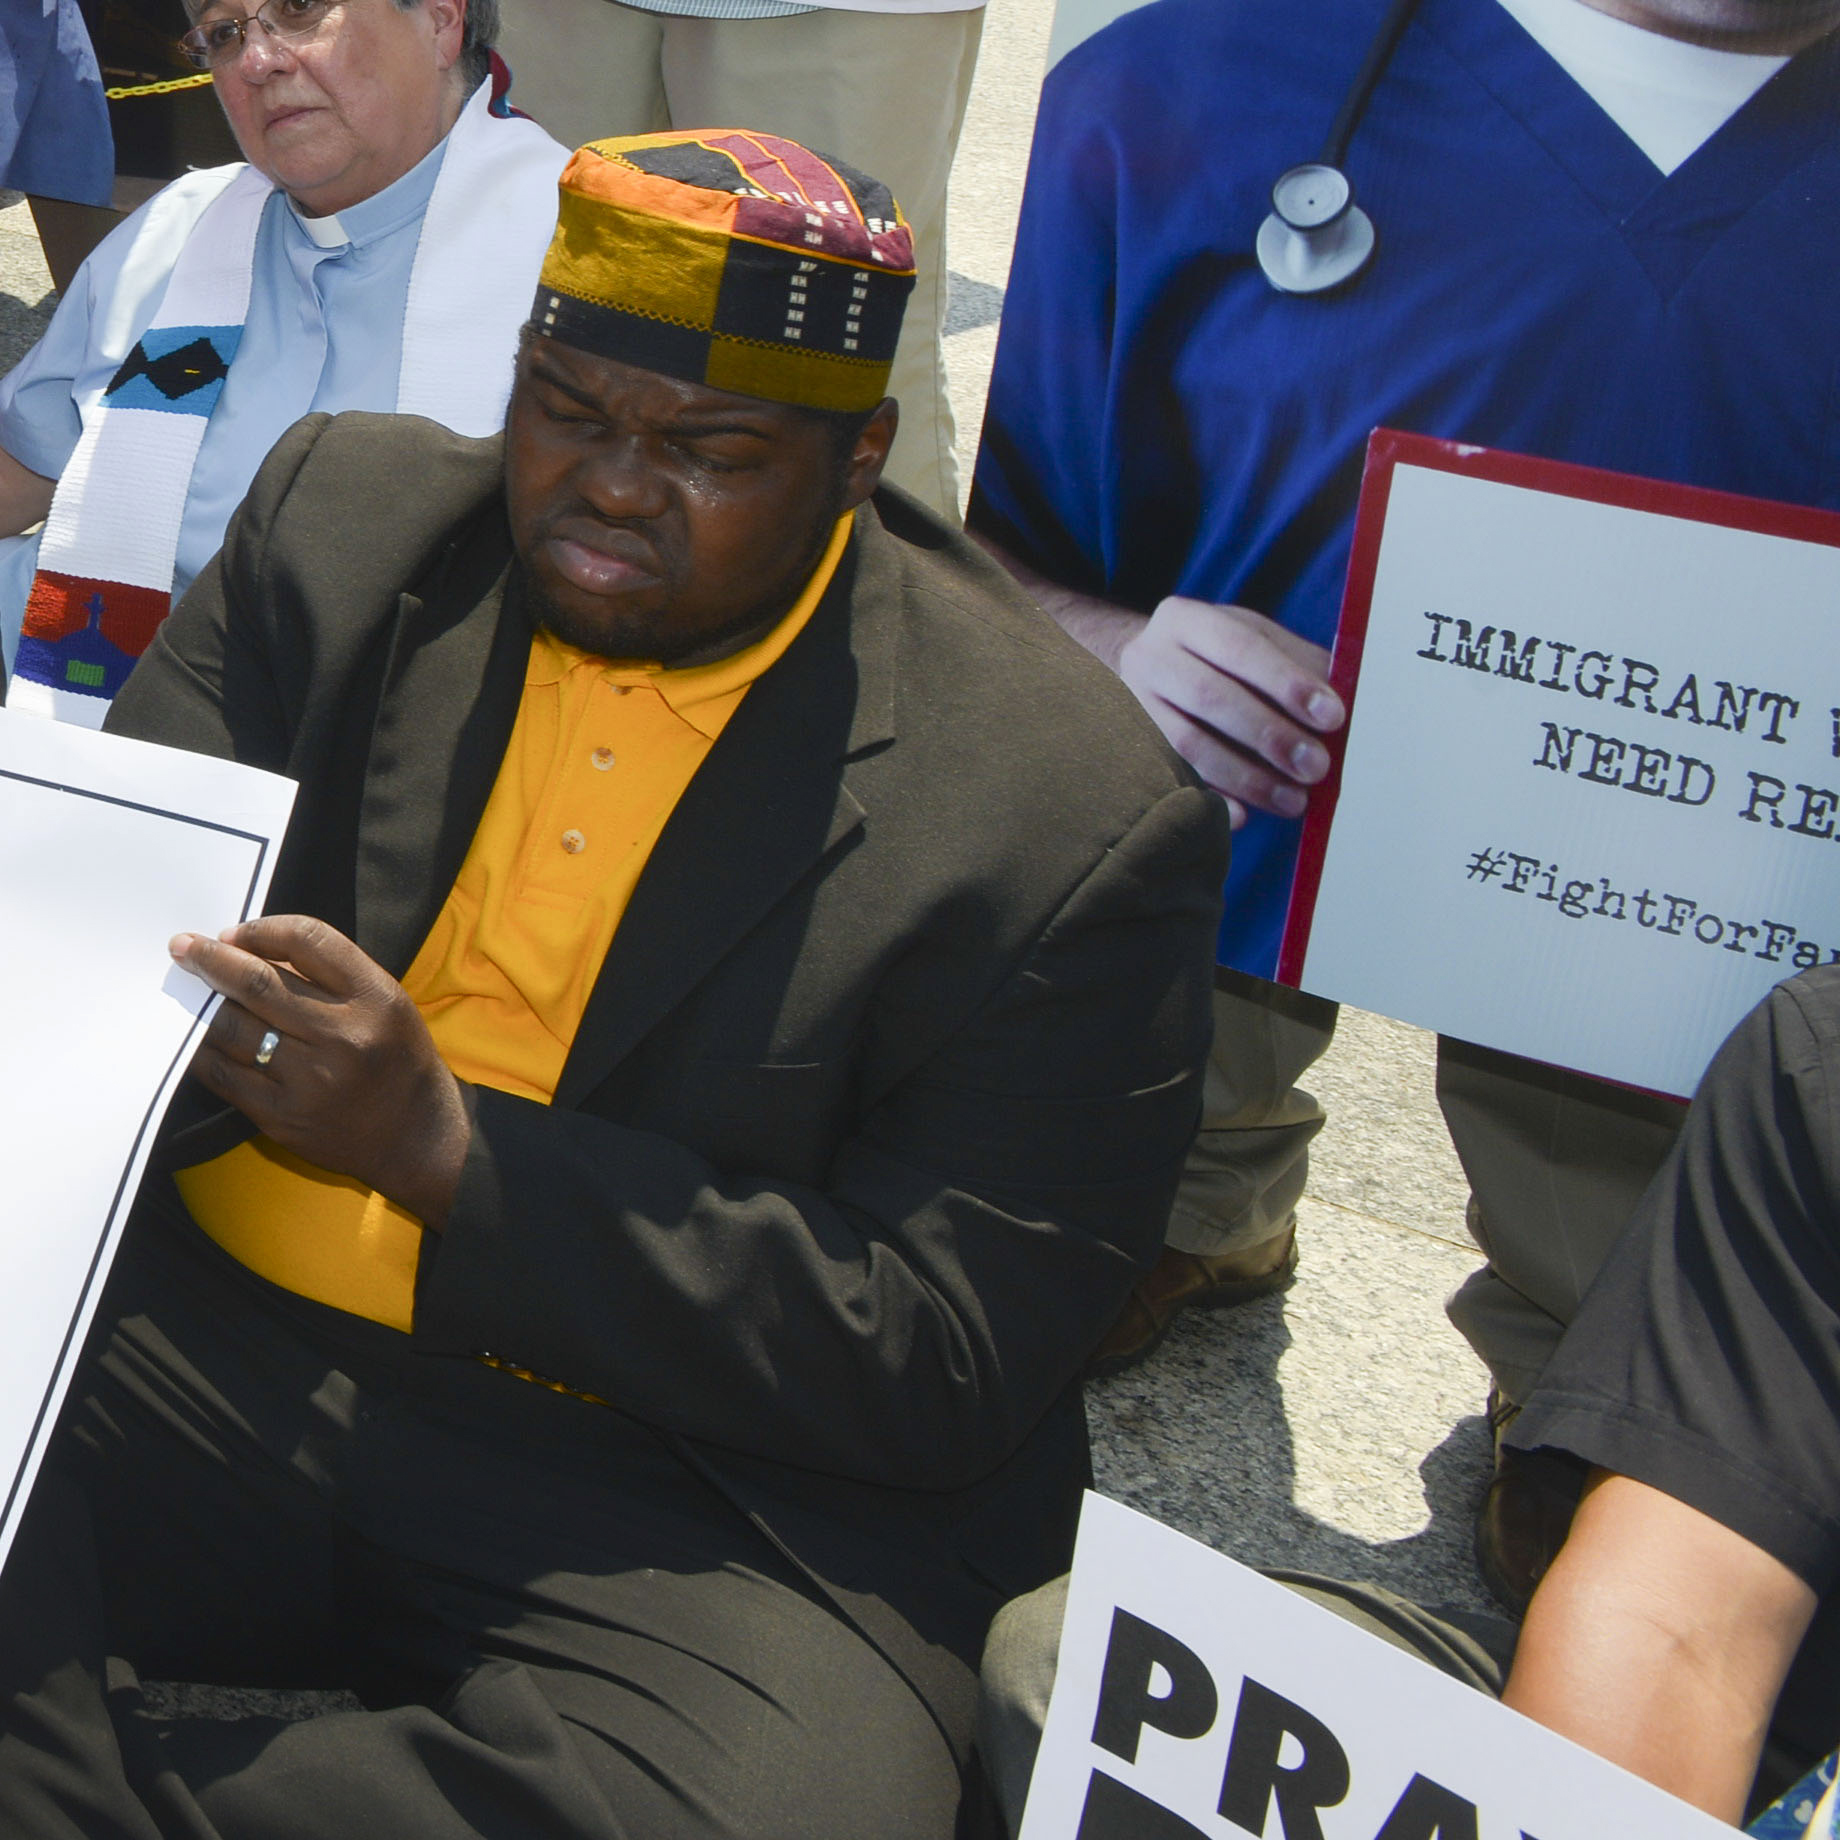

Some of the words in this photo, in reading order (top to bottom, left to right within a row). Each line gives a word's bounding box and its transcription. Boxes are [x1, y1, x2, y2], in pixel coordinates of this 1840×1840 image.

[1416, 611, 1800, 745] IMMIGRANT
[1533, 722, 1716, 806] NEED
[1465, 846, 1840, 969] #FightForFa
